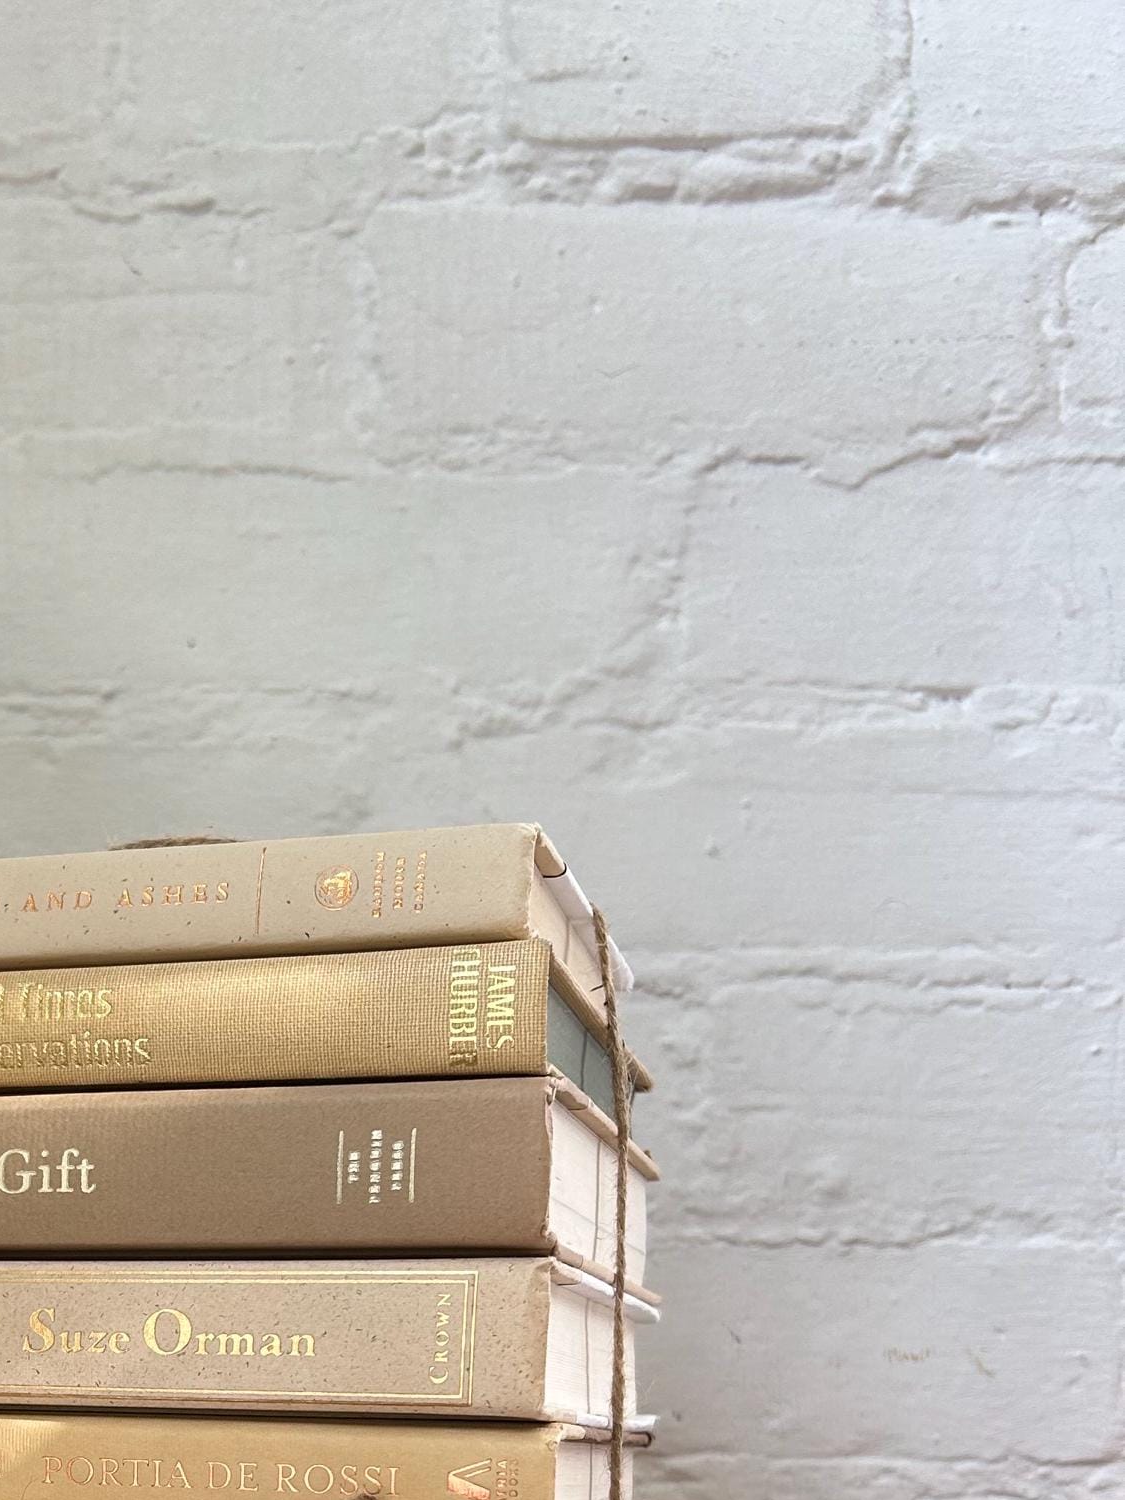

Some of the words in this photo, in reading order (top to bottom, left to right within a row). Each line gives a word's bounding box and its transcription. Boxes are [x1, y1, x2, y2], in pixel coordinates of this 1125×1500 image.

[20, 890, 92, 914] AND
[117, 881, 230, 909] ASHES
[18, 981, 113, 1020] Times
[449, 947, 481, 1067] THURBER
[486, 963, 517, 1051] JAMES
[23, 1307, 131, 1355] Suze
[142, 1308, 317, 1358] Orman
[429, 1292, 452, 1385] CROWN
[41, 1454, 192, 1489] PORTIA
[206, 1460, 259, 1492] DE
[275, 1463, 401, 1497] ROSSI
